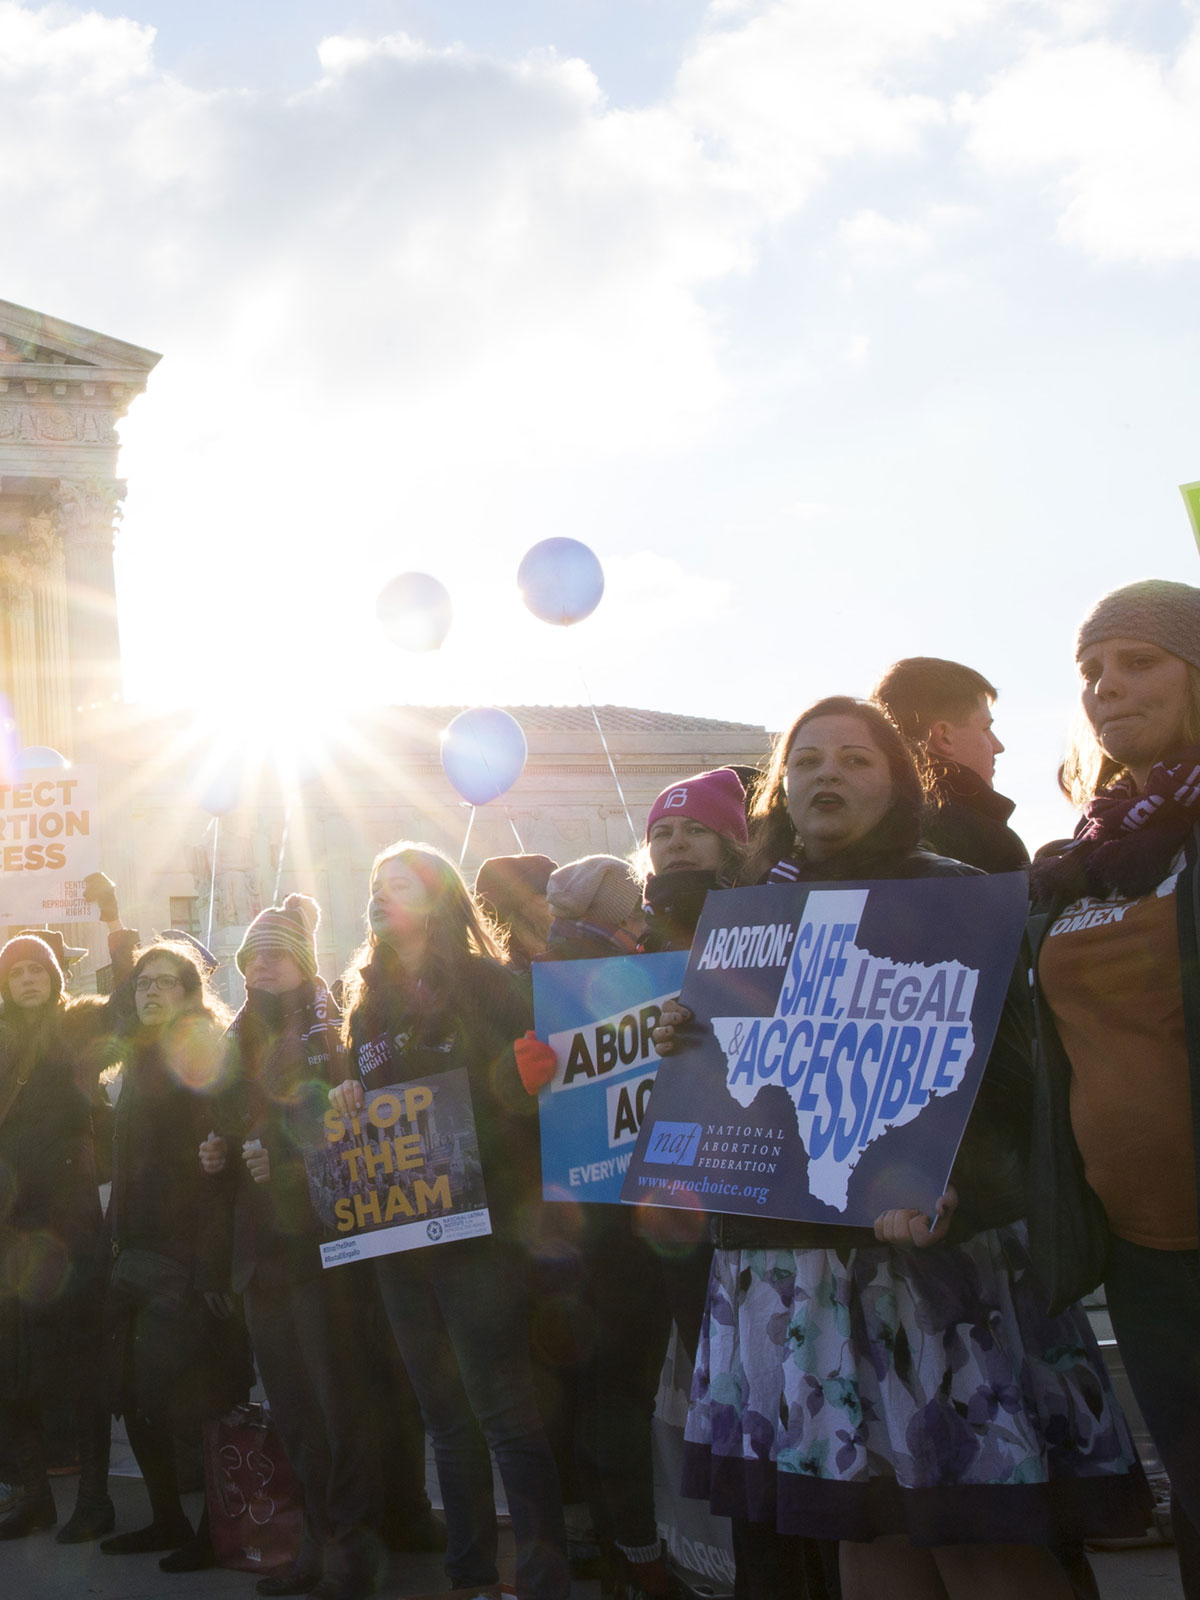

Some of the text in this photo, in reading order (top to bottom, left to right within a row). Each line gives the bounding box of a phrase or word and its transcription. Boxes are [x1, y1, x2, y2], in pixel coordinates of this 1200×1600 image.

[64, 881, 87, 890] CENTE
[65, 907, 91, 917] RIGHTS
[1050, 905, 1131, 936] OMEN
[697, 923, 794, 970] ABORTION:
[846, 959, 969, 1023] LEGAL
[562, 1000, 666, 1086] ABOR
[729, 1020, 968, 1163] ACCESSIBLE
[653, 1122, 699, 1166] naf
[706, 1125, 785, 1140] NATIONAL
[341, 1133, 425, 1183] THE
[702, 1141, 782, 1157] ABORTION
[569, 1158, 614, 1187] EVERY
[698, 1158, 777, 1173] FEDERATION
[334, 1174, 453, 1232] SHAM
[638, 1175, 770, 1205] www.prochoice.org
